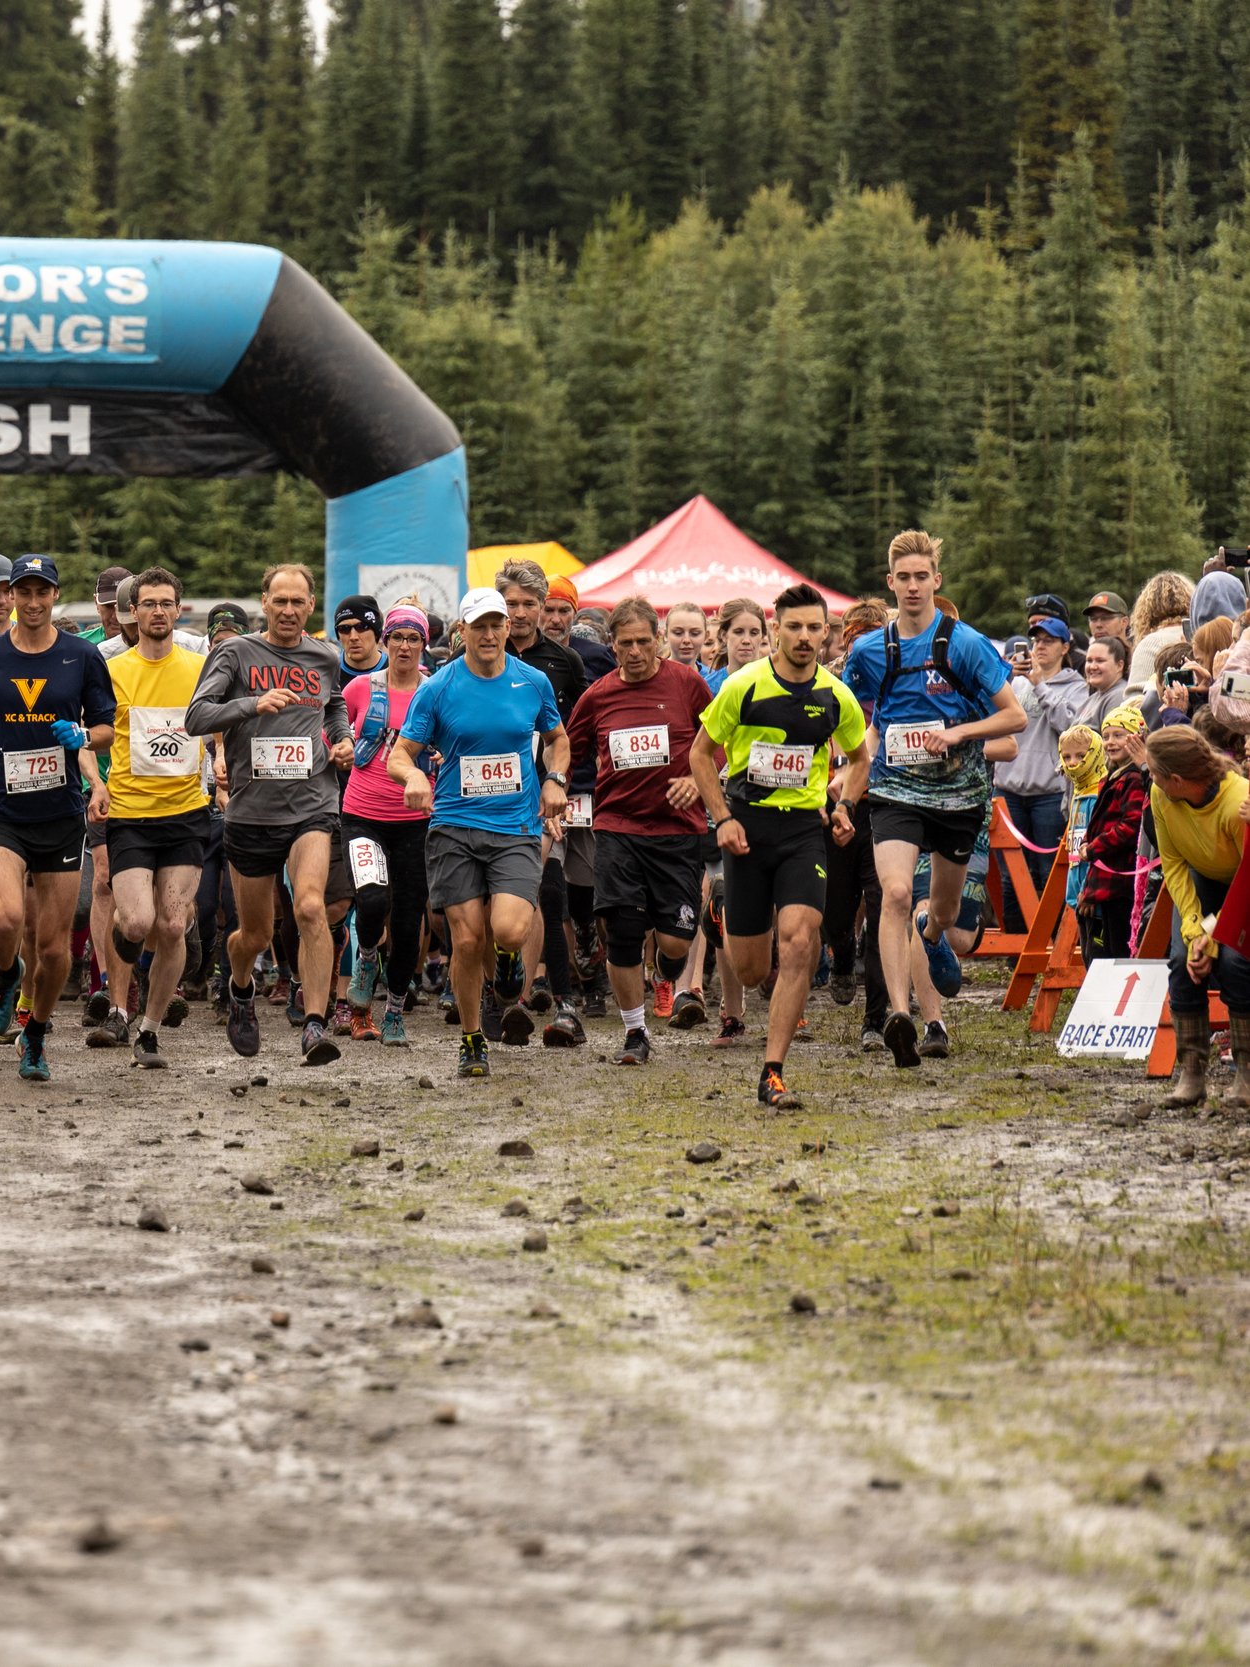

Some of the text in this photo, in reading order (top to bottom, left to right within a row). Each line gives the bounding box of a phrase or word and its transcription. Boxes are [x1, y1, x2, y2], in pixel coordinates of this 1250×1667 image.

[249, 664, 322, 696] NVSS
[10, 678, 47, 712] V
[4, 713, 57, 722] XC & TRACK
[149, 742, 179, 757] 260
[629, 733, 661, 753] 834
[274, 745, 306, 763] 726
[772, 753, 805, 773] 646
[25, 755, 58, 775] 725
[481, 761, 513, 780] 645
[356, 843, 374, 867] 934
[1059, 1023, 1158, 1048] RACE START
